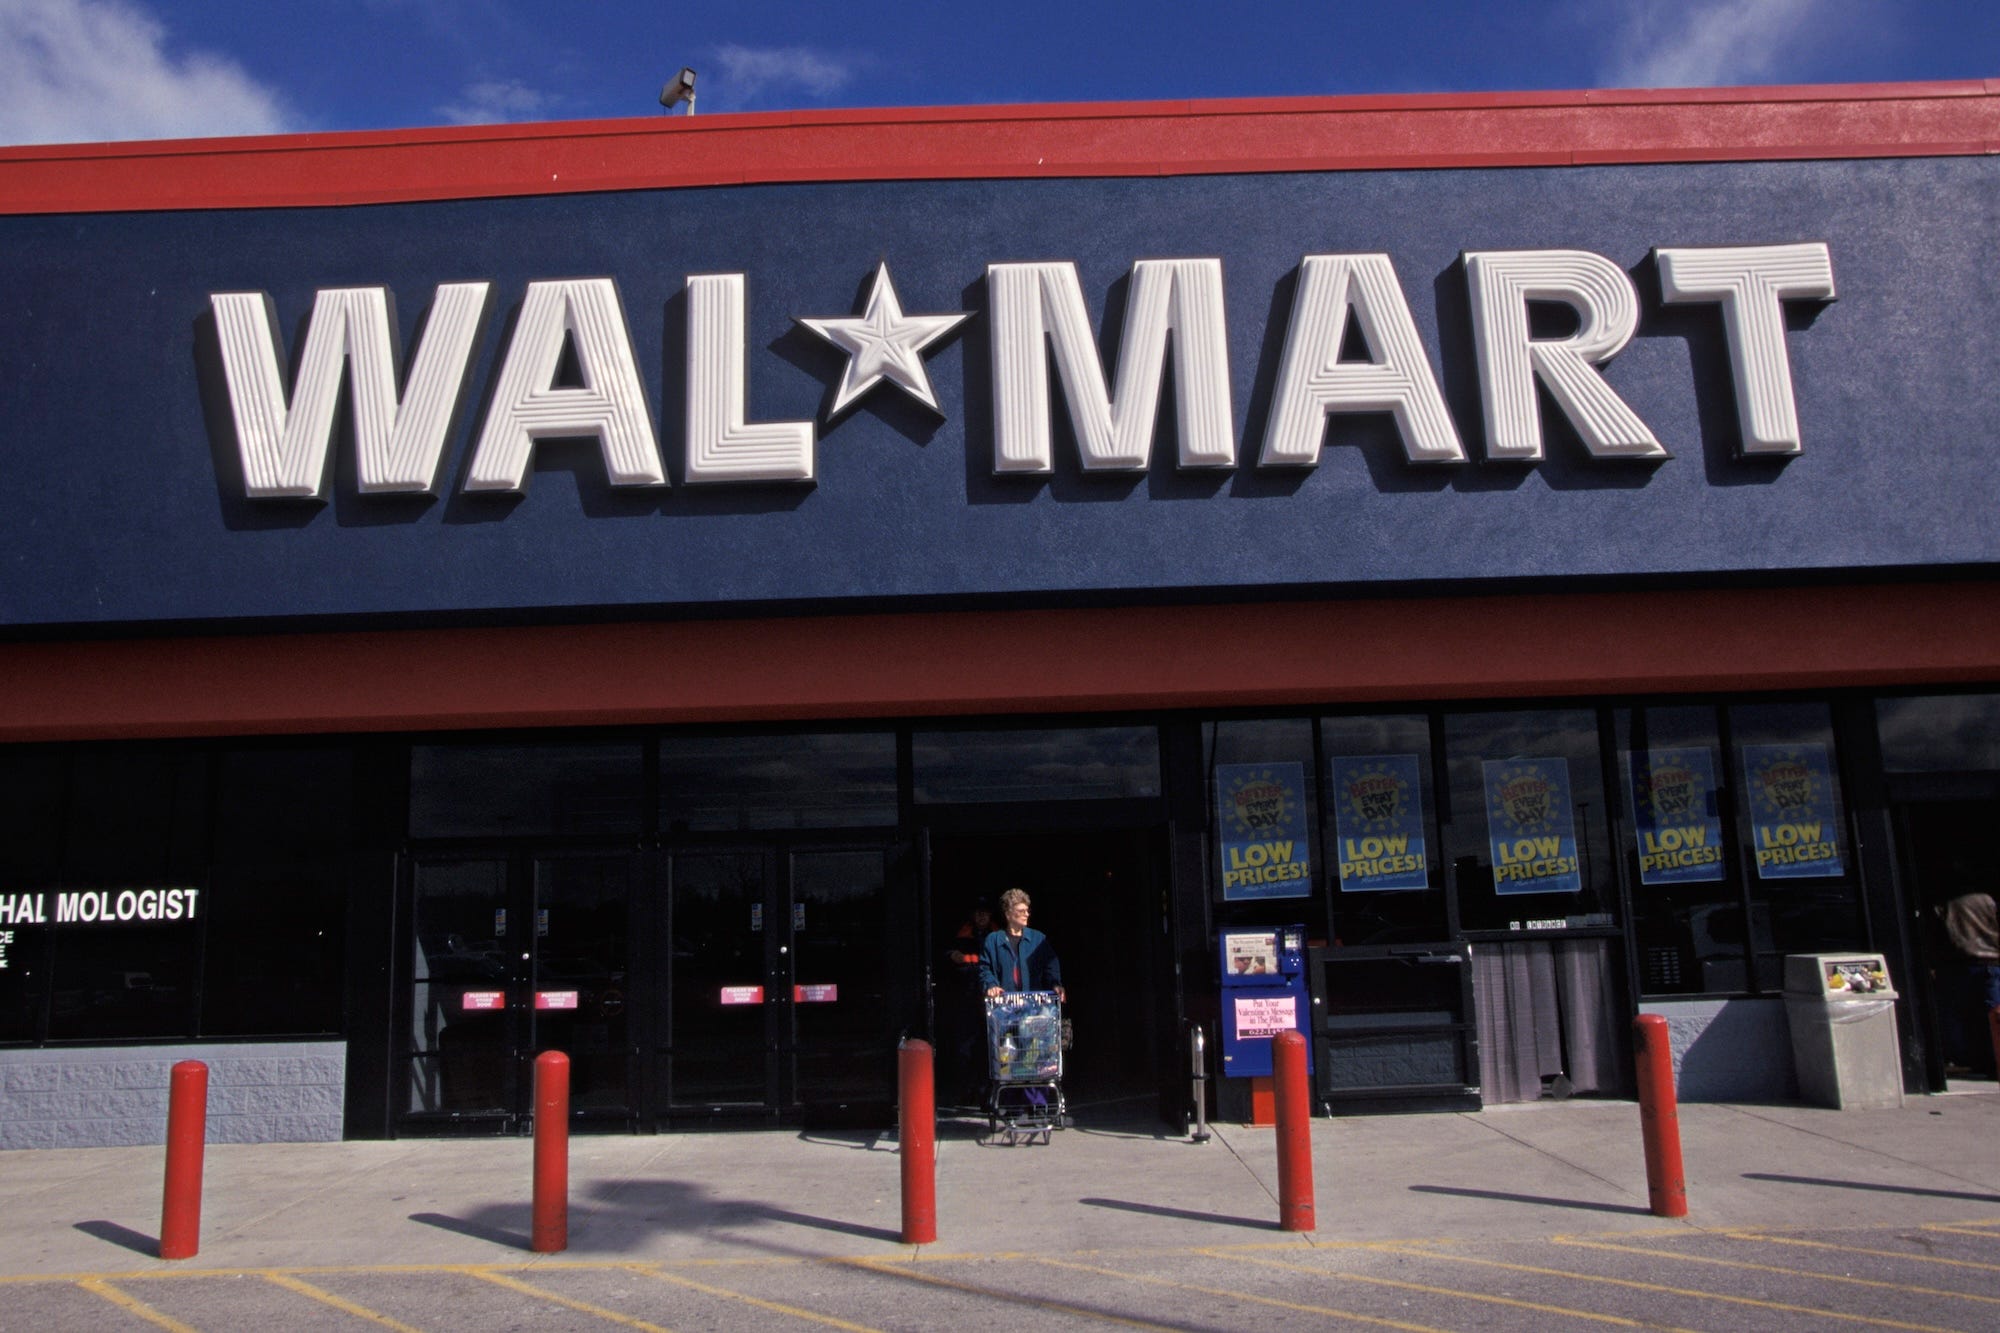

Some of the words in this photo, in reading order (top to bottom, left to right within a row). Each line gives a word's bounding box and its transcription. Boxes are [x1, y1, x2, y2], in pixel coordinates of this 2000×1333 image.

[1246, 798, 1278, 814] EVERY
[1360, 790, 1395, 806] EVERY
[1362, 802, 1395, 820] DAY
[1247, 811, 1279, 829] DAY
[1345, 832, 1409, 861] LOW
[1644, 824, 1706, 854] LOW
[1761, 820, 1822, 849] LOW
[1230, 840, 1295, 870] LOW
[1498, 835, 1560, 865] LOW
[1641, 847, 1722, 872] PRICES!
[1758, 841, 1838, 867] PRICES!
[1225, 861, 1309, 888] PRICES!
[1341, 853, 1425, 879] PRICES!
[1494, 856, 1577, 883] PRICES!
[56, 889, 199, 922] MOLOGIST
